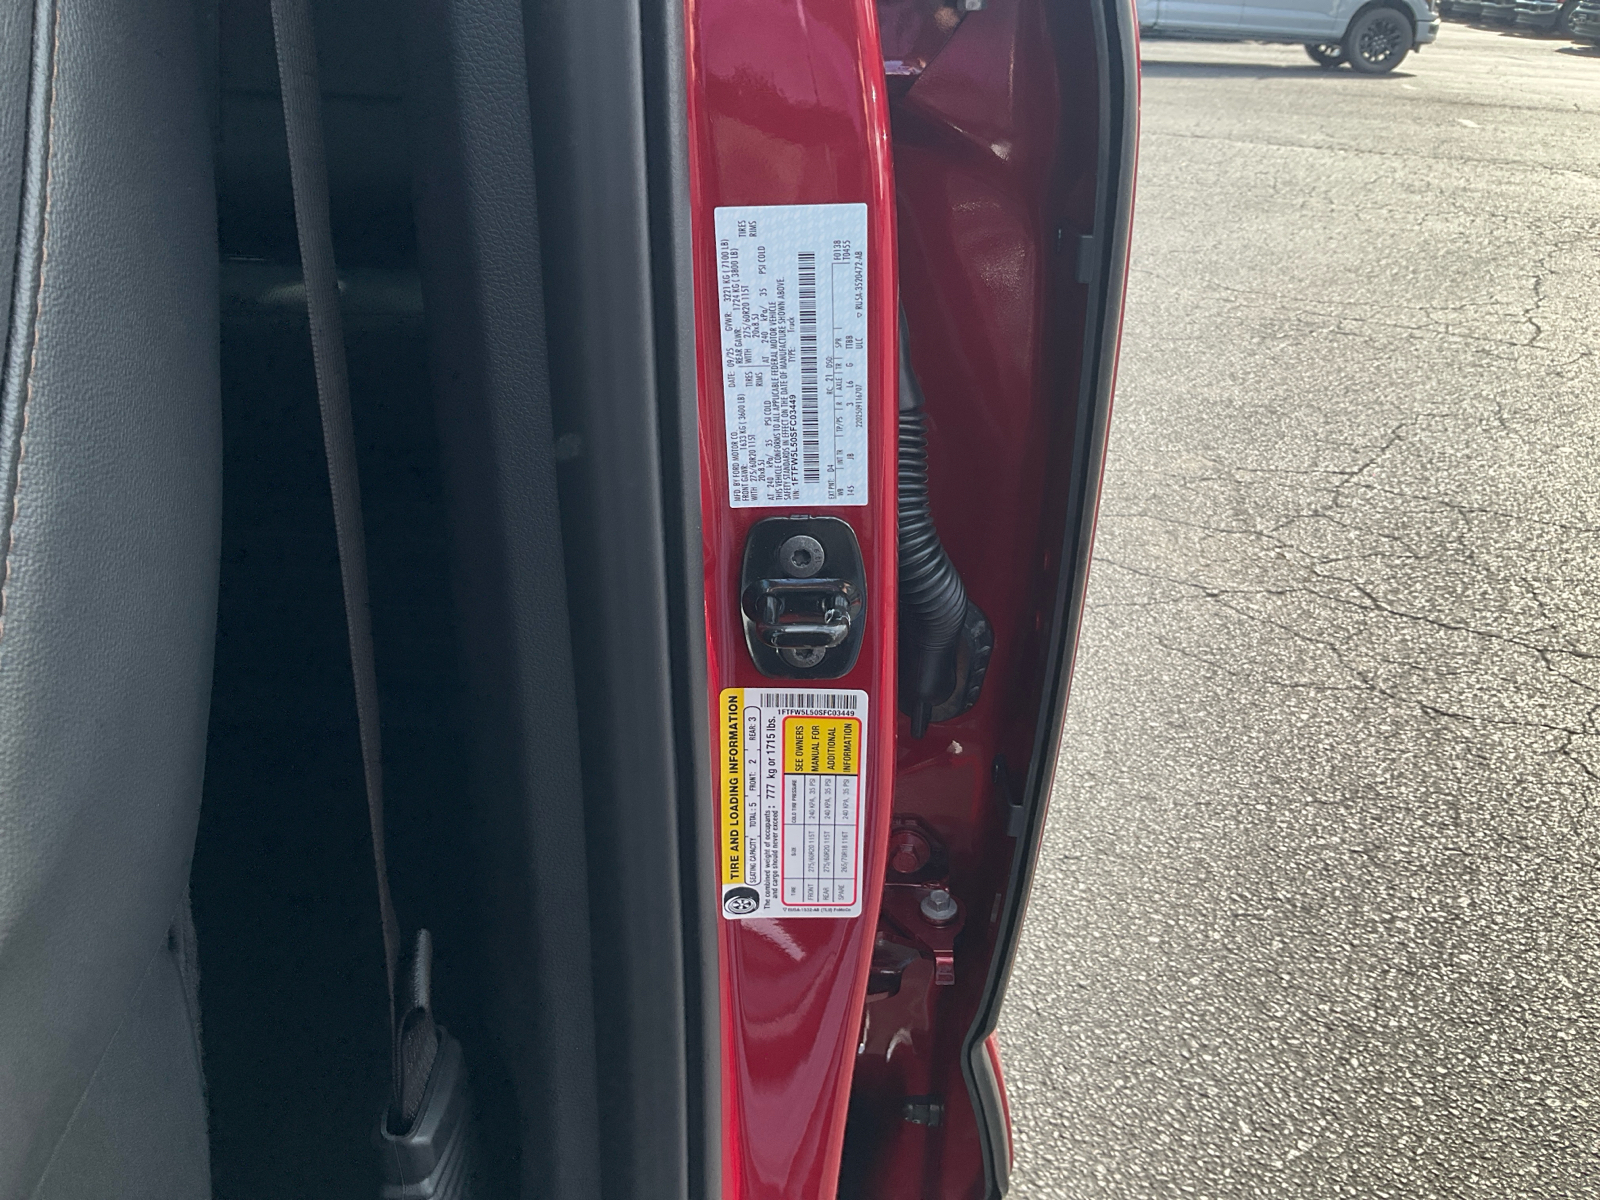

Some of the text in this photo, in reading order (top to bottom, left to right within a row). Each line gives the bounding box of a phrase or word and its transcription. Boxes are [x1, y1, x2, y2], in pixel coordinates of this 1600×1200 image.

[748, 221, 757, 237] RIMS
[833, 240, 841, 260] F0138
[842, 240, 850, 260] T0455
[758, 265, 766, 274] PSI
[722, 275, 730, 284] KG
[732, 284, 740, 292] KG
[723, 287, 731, 302] 3221
[738, 220, 752, 364] WITH 275/60R20 115T TIRES
[759, 288, 767, 296] 35
[725, 312, 733, 331] GVWR:
[768, 302, 776, 325] VEHICLE
[778, 326, 787, 369] MANUFACTURE
[855, 338, 863, 349] ULC
[726, 348, 734, 367] 09/25
[735, 349, 743, 364] REAR
[788, 347, 796, 362] TYPE:
[745, 372, 753, 387] TIRES
[755, 372, 763, 386] RIMS
[780, 381, 788, 395] DATE
[764, 417, 772, 426] PSI
[781, 409, 788, 417] ON
[739, 426, 746, 434] KG
[781, 419, 789, 438] EFFECT
[789, 394, 798, 486] 1FTFW5L50SFC03449
[749, 450, 757, 482] 275/60R20
[782, 448, 790, 480] STANDARDS
[827, 728, 835, 770] ADDITIONAL
[843, 723, 852, 772] INFORMATION
[766, 716, 777, 799] 777 kg or 1715 lbs.
[795, 759, 803, 771] SEE
[811, 742, 819, 772] MANUAL
[728, 696, 739, 879] TIRE AND LOADING INFORMATION
